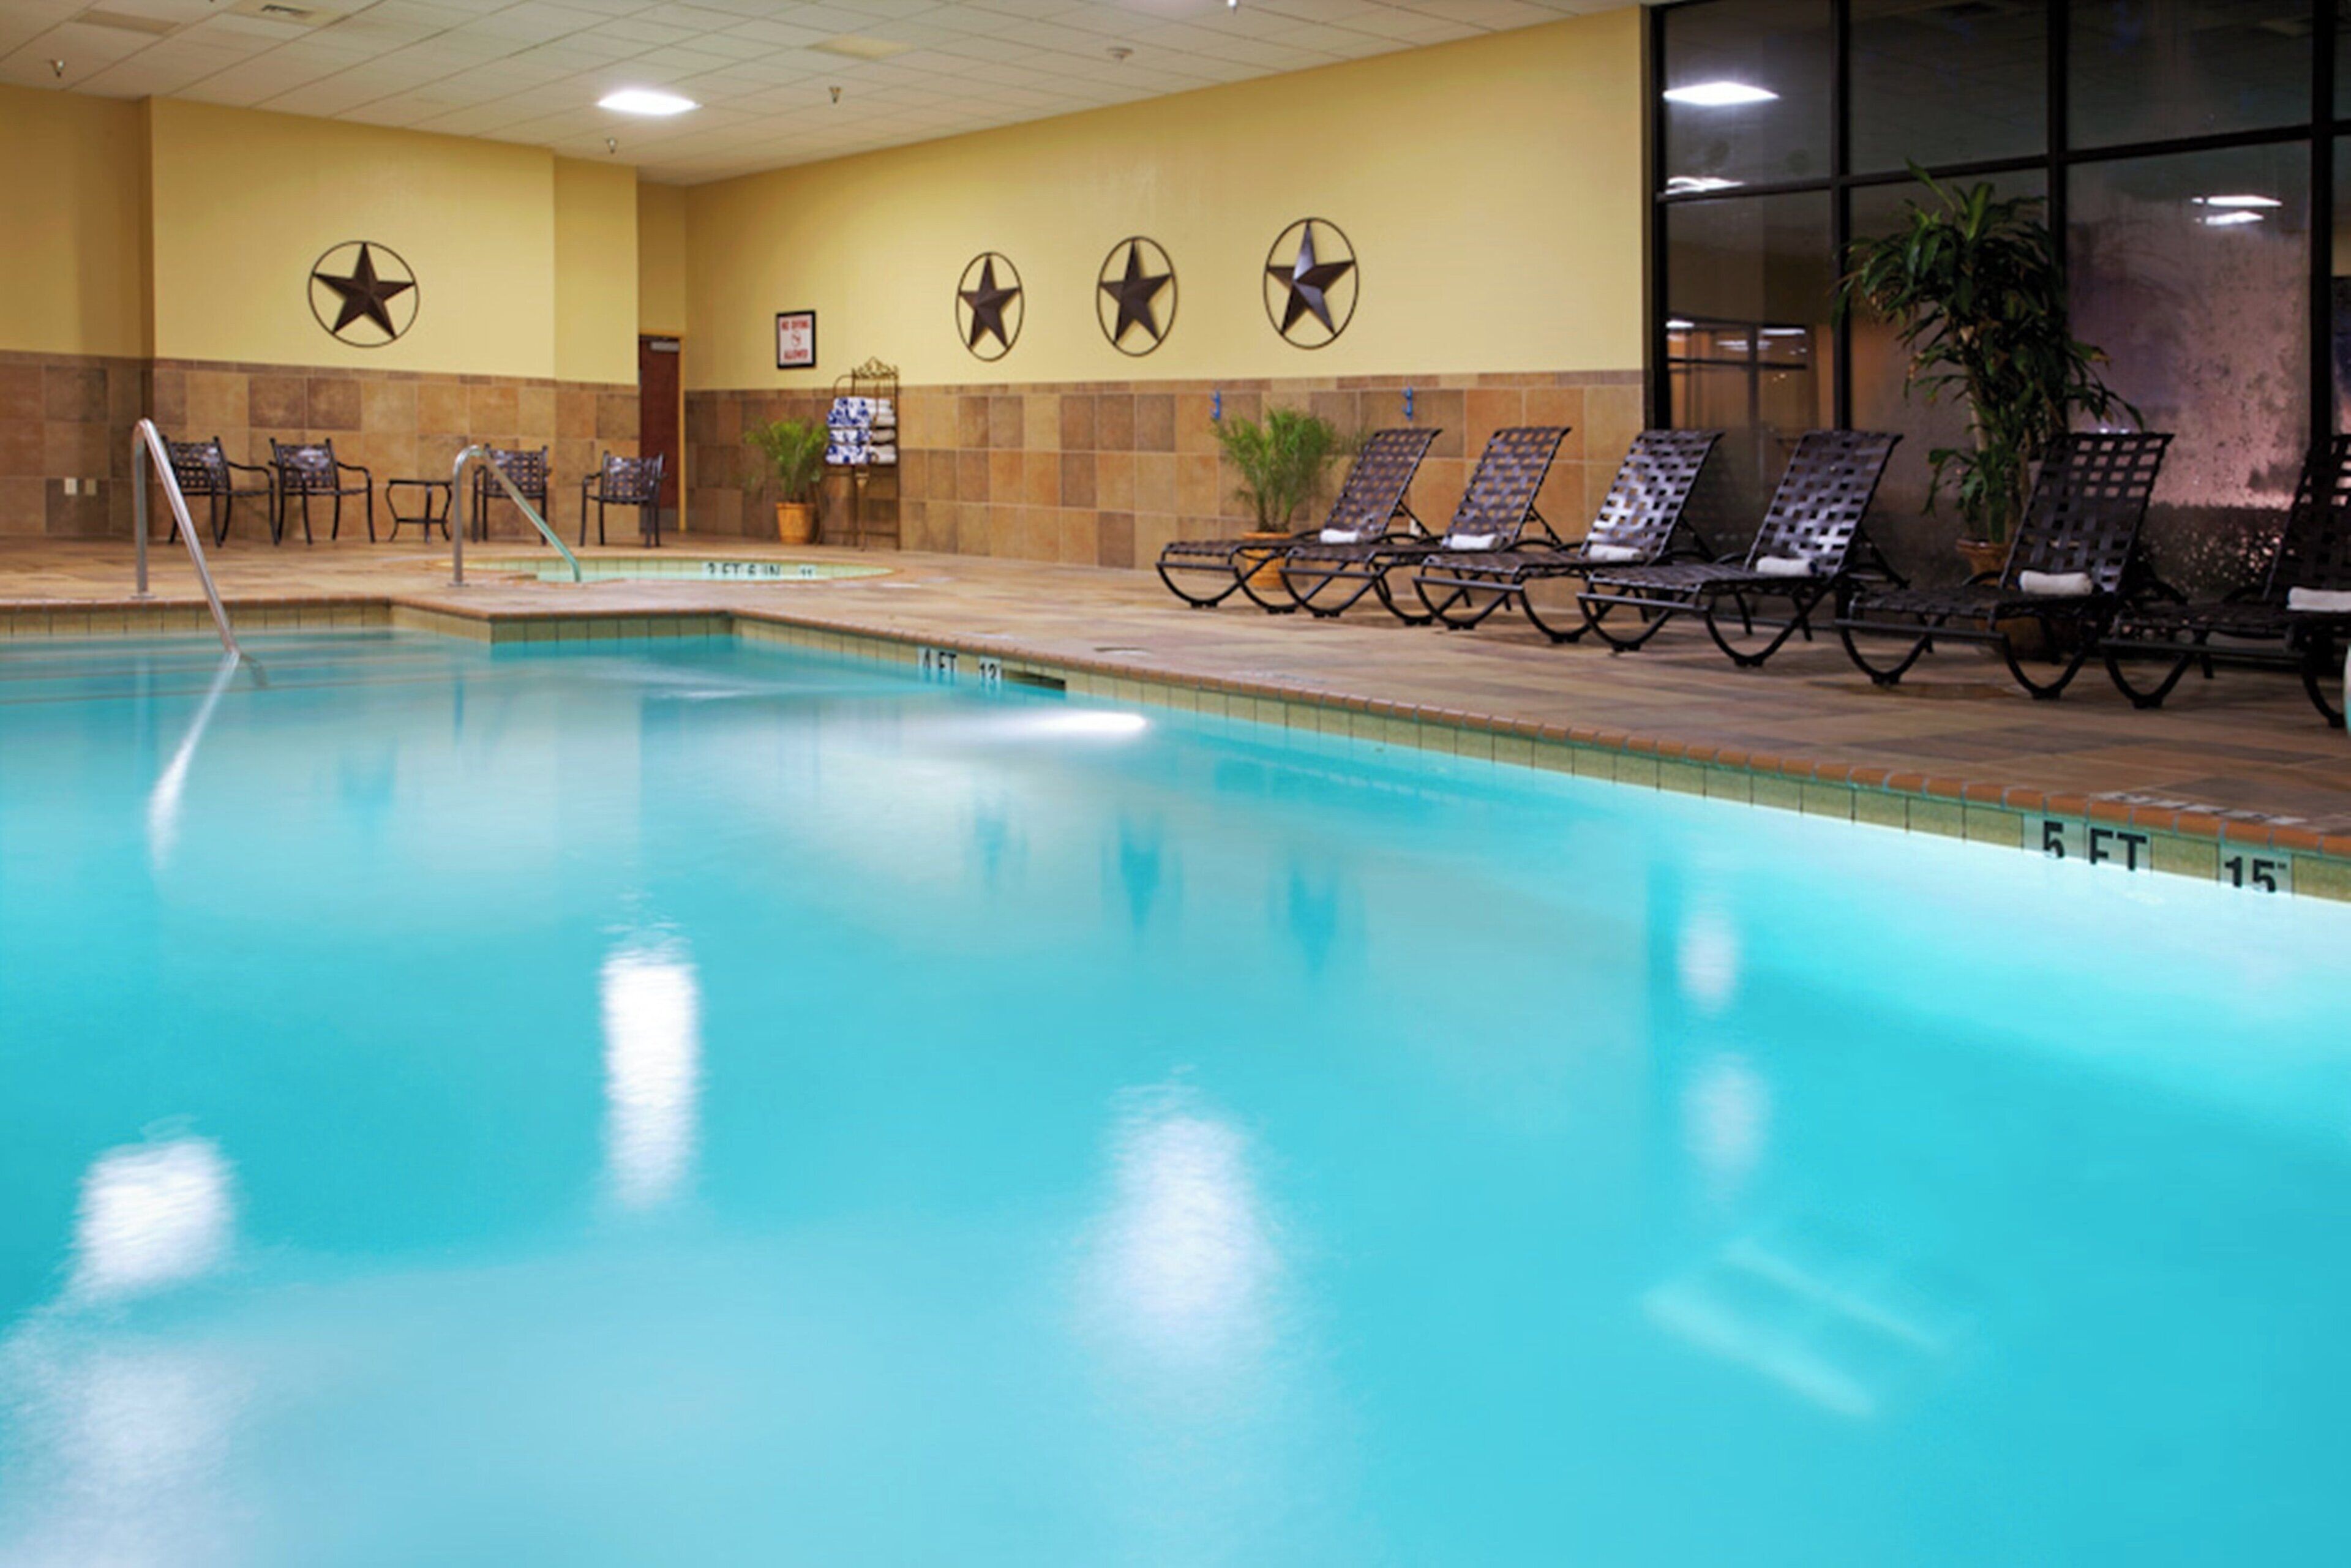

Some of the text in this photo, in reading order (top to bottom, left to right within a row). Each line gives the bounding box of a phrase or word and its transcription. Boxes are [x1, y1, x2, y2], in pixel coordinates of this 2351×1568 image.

[938, 650, 957, 672] FT
[2043, 820, 2064, 858] 5
[2090, 827, 2147, 872] FT
